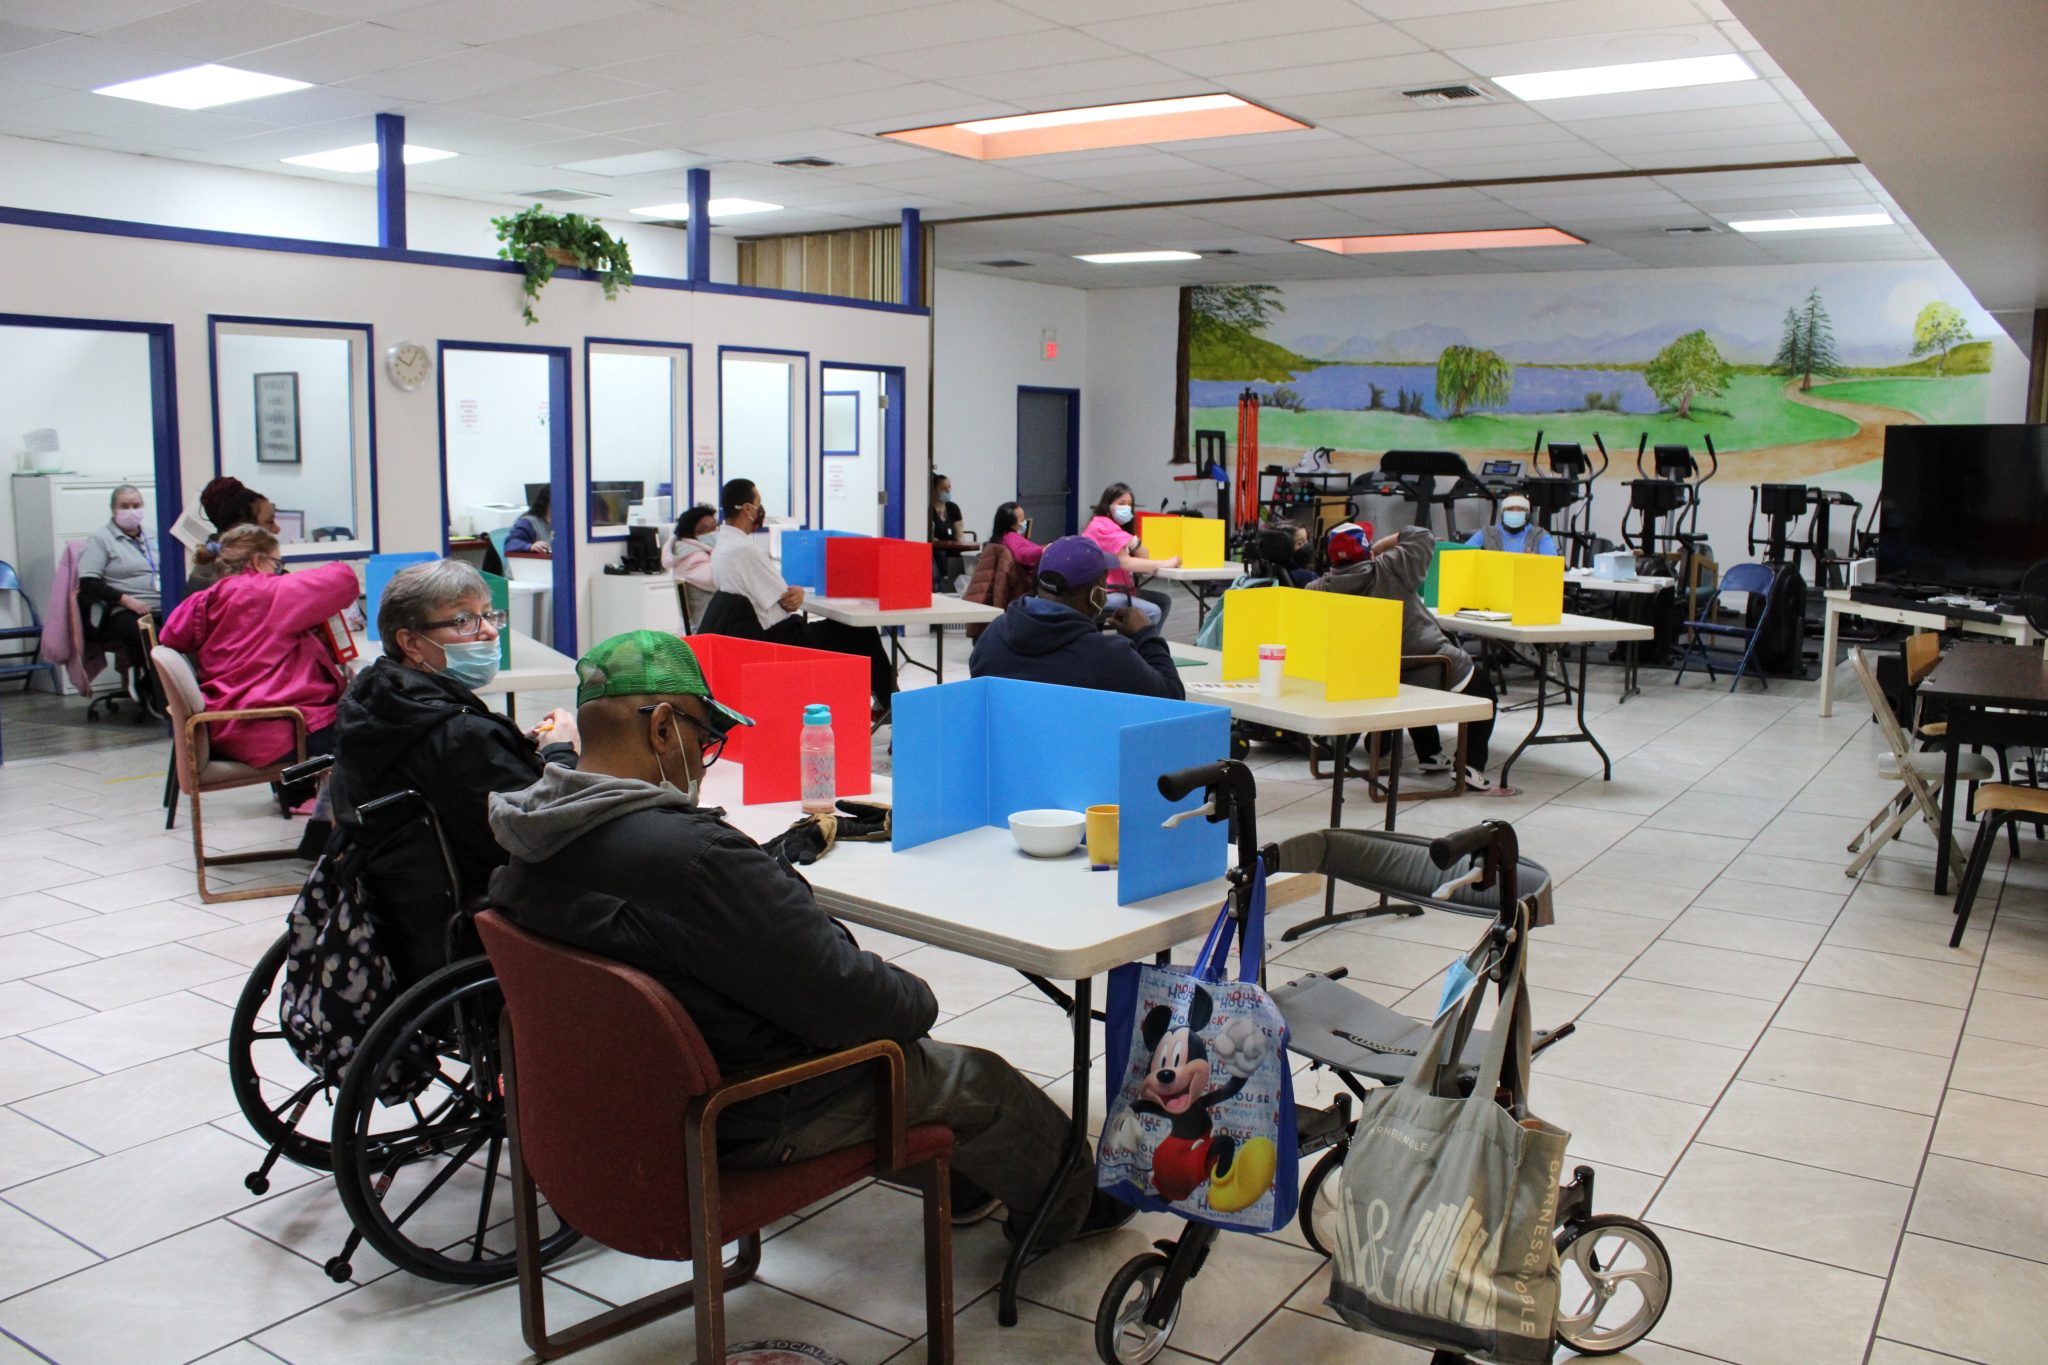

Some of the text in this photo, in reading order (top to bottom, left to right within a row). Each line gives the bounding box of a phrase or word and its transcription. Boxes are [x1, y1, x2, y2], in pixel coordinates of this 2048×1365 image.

[1169, 985, 1195, 1003] HOUS
[1231, 1092, 1270, 1104] OUSE
[1530, 1160, 1560, 1251] BARNES
[1523, 1252, 1540, 1267] &
[766, 1339, 823, 1358] SOCIAL
